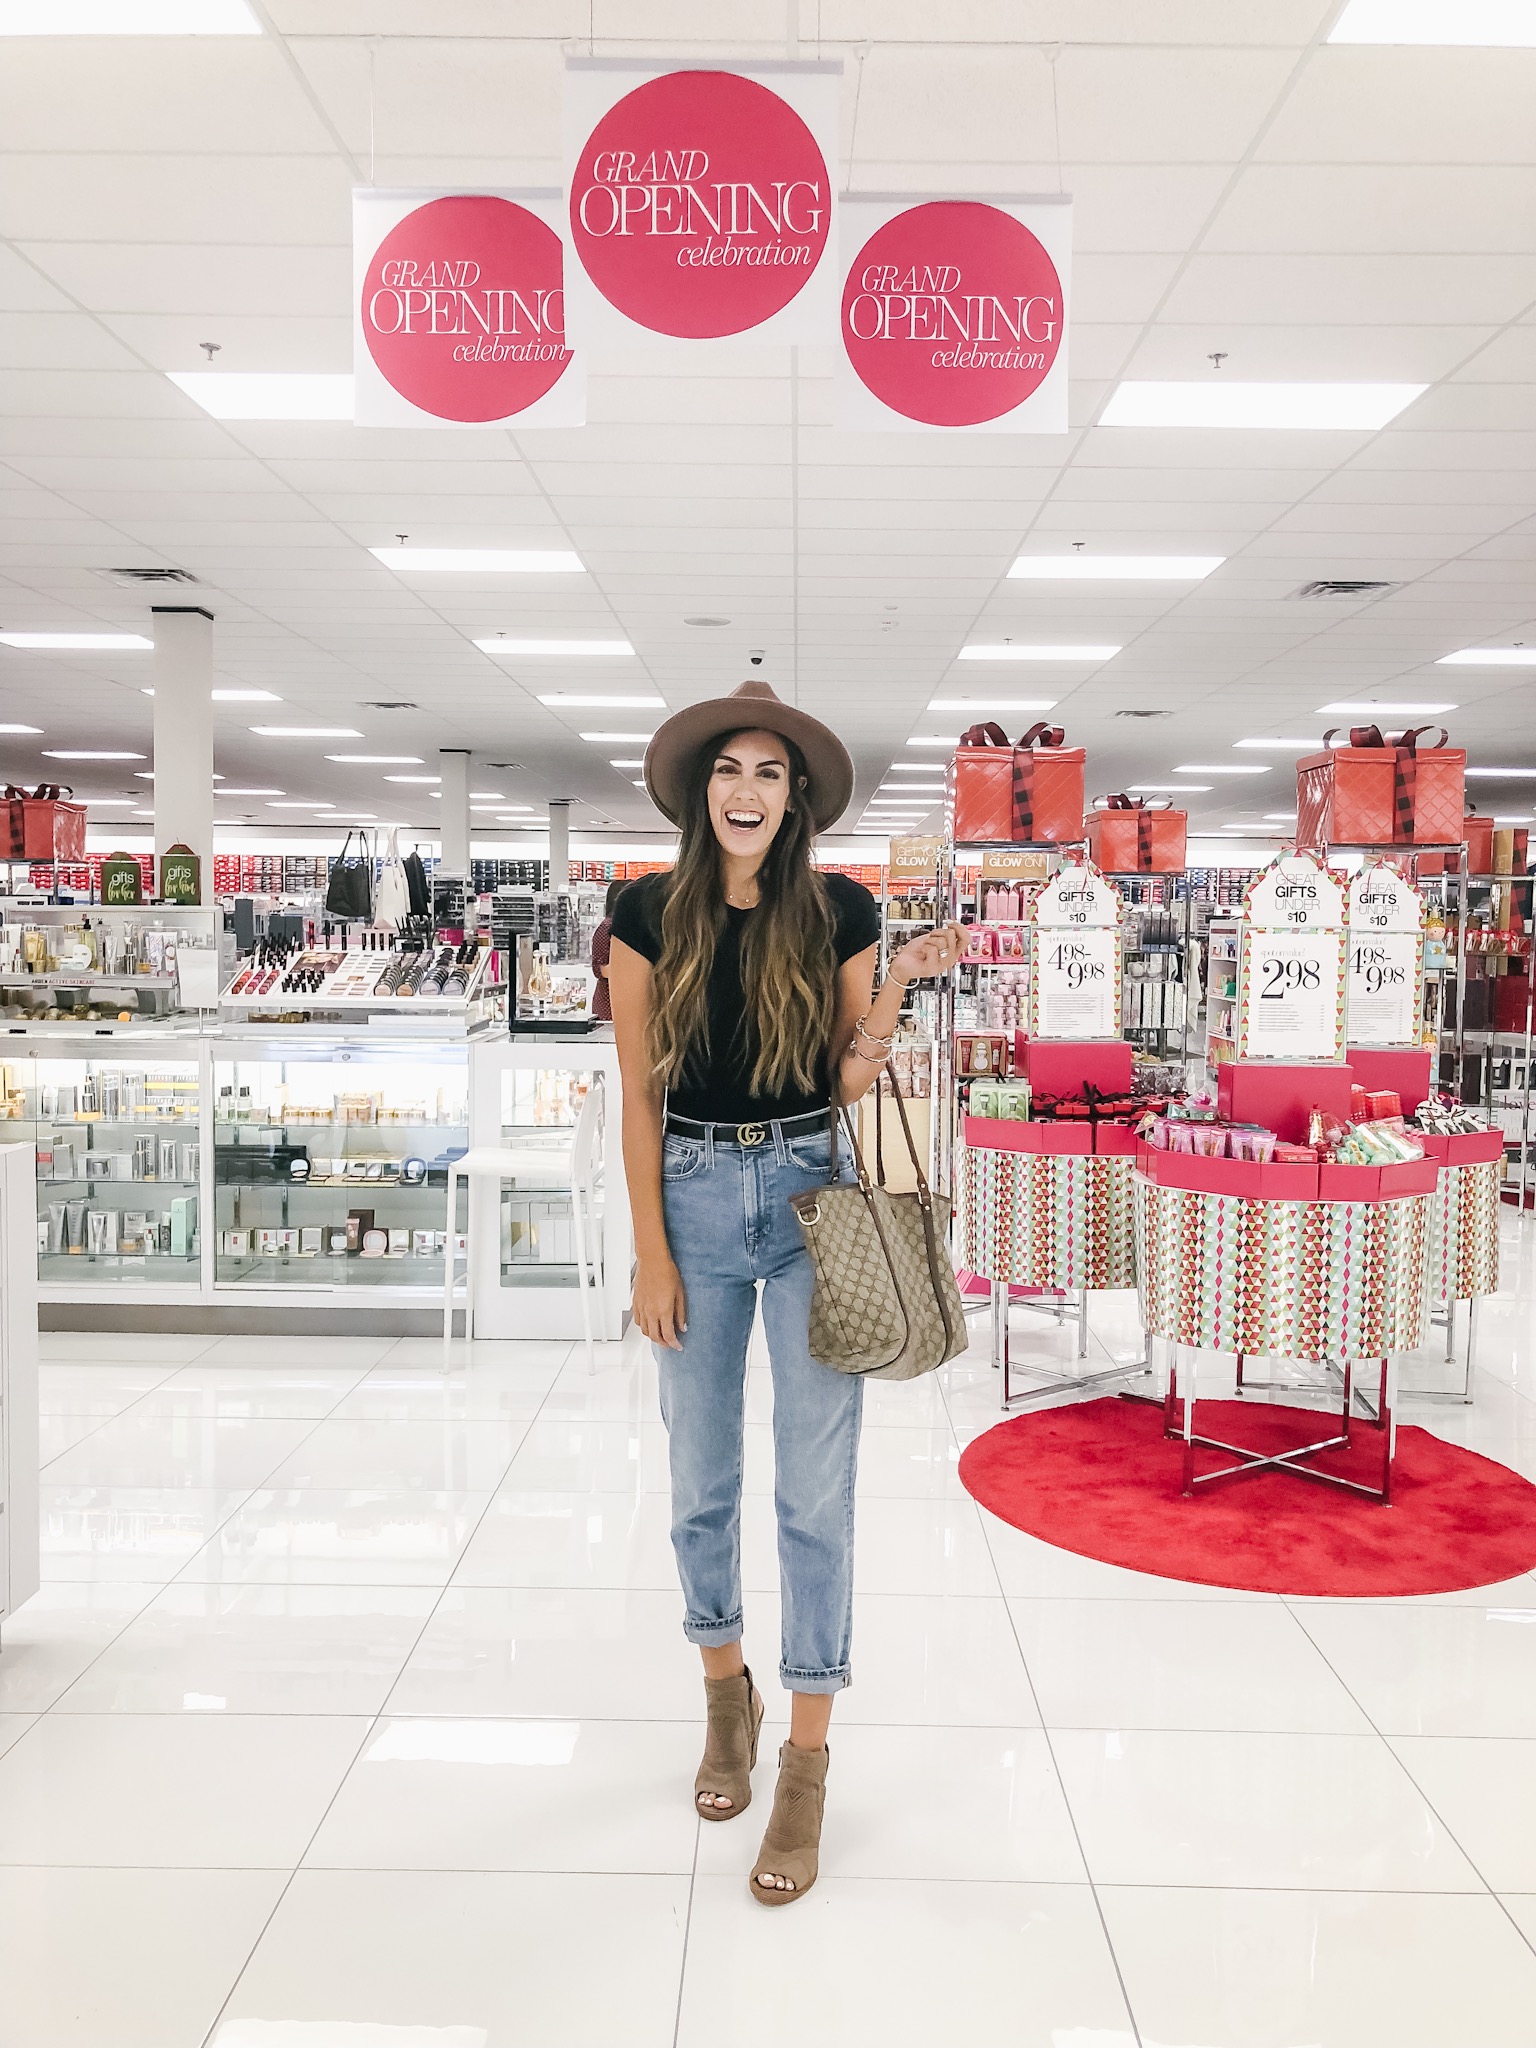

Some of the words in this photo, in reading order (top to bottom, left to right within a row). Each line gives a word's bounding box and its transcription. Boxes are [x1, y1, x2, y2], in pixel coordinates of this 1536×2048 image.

[593, 150, 709, 183] GRAND
[579, 181, 824, 237] OPENING
[677, 235, 811, 267] celebration
[381, 260, 481, 288] GRAND
[861, 265, 962, 293] GRAND
[849, 293, 1057, 343] OPENING
[452, 335, 566, 362] celebration
[931, 341, 1046, 370] celebration
[896, 846, 917, 857] GET
[895, 856, 929, 866] GLOW
[989, 857, 1022, 868] GLOW
[111, 871, 135, 886] gifts
[168, 865, 192, 880] gifts
[1058, 880, 1096, 891] GREAT
[1275, 873, 1319, 886] GREAT
[1275, 886, 1317, 898] GIFTS
[1360, 883, 1398, 893] GREAT
[1058, 891, 1095, 902] GIFTS
[1359, 893, 1397, 904] GIFTS
[1058, 901, 1098, 912] UNDER
[1274, 898, 1321, 911] UNDER
[1358, 905, 1400, 915] UNDER
[1069, 912, 1087, 923] $10
[1287, 911, 1307, 923] $10
[1369, 915, 1388, 926] $10
[1260, 958, 1321, 999] 298
